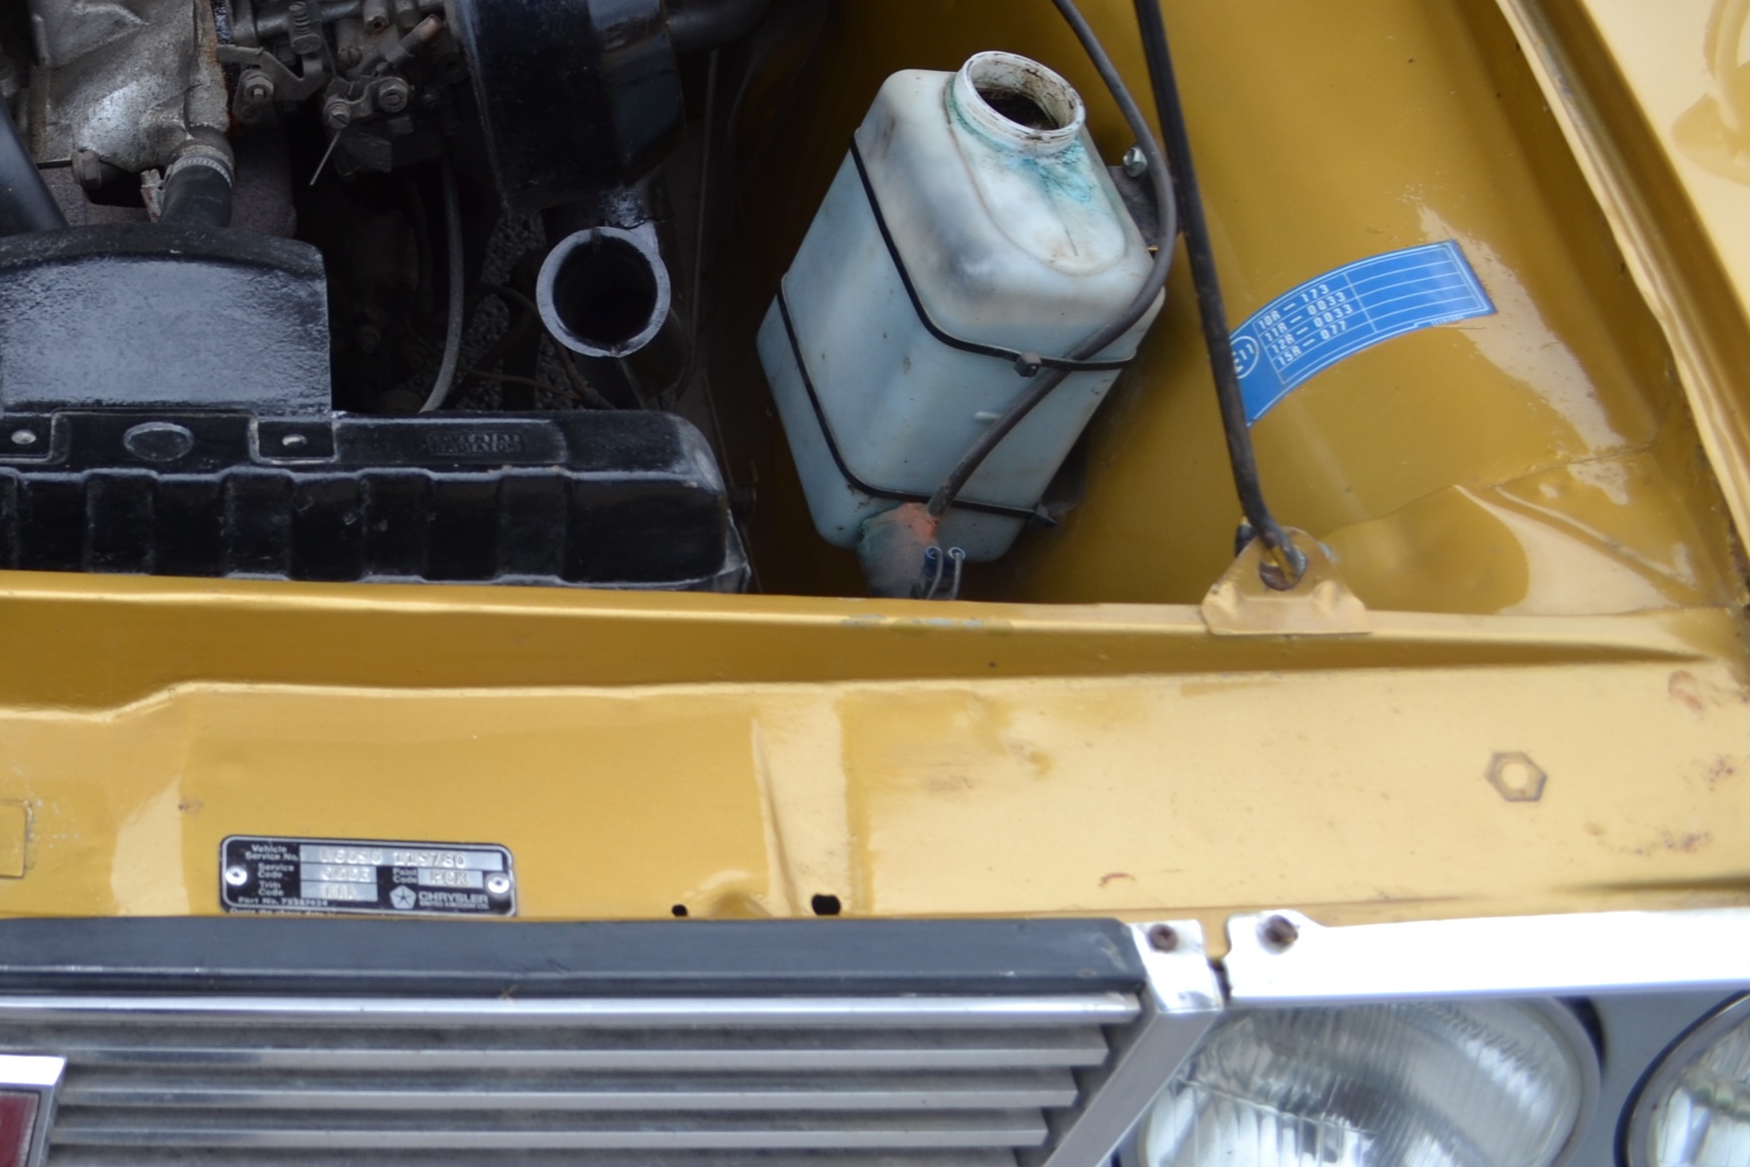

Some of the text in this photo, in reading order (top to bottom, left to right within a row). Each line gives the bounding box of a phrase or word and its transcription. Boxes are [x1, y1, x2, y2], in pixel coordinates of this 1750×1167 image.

[1258, 310, 1281, 330] 10R
[1300, 284, 1329, 303] 173
[1265, 322, 1288, 342] 11R
[1307, 292, 1346, 315] 0033
[1272, 334, 1295, 354] 12R
[1313, 304, 1353, 328] 0033
[1278, 345, 1302, 366] 15R
[1320, 320, 1347, 340] 077
[251, 844, 287, 853] Vehicle
[245, 851, 281, 861] Service
[258, 862, 295, 872] Service
[392, 867, 418, 876] Paint
[257, 870, 283, 879] Code
[392, 874, 418, 884] Code
[259, 880, 281, 889] Trim
[258, 889, 284, 897] Code
[418, 891, 488, 904] CHRYSLER
